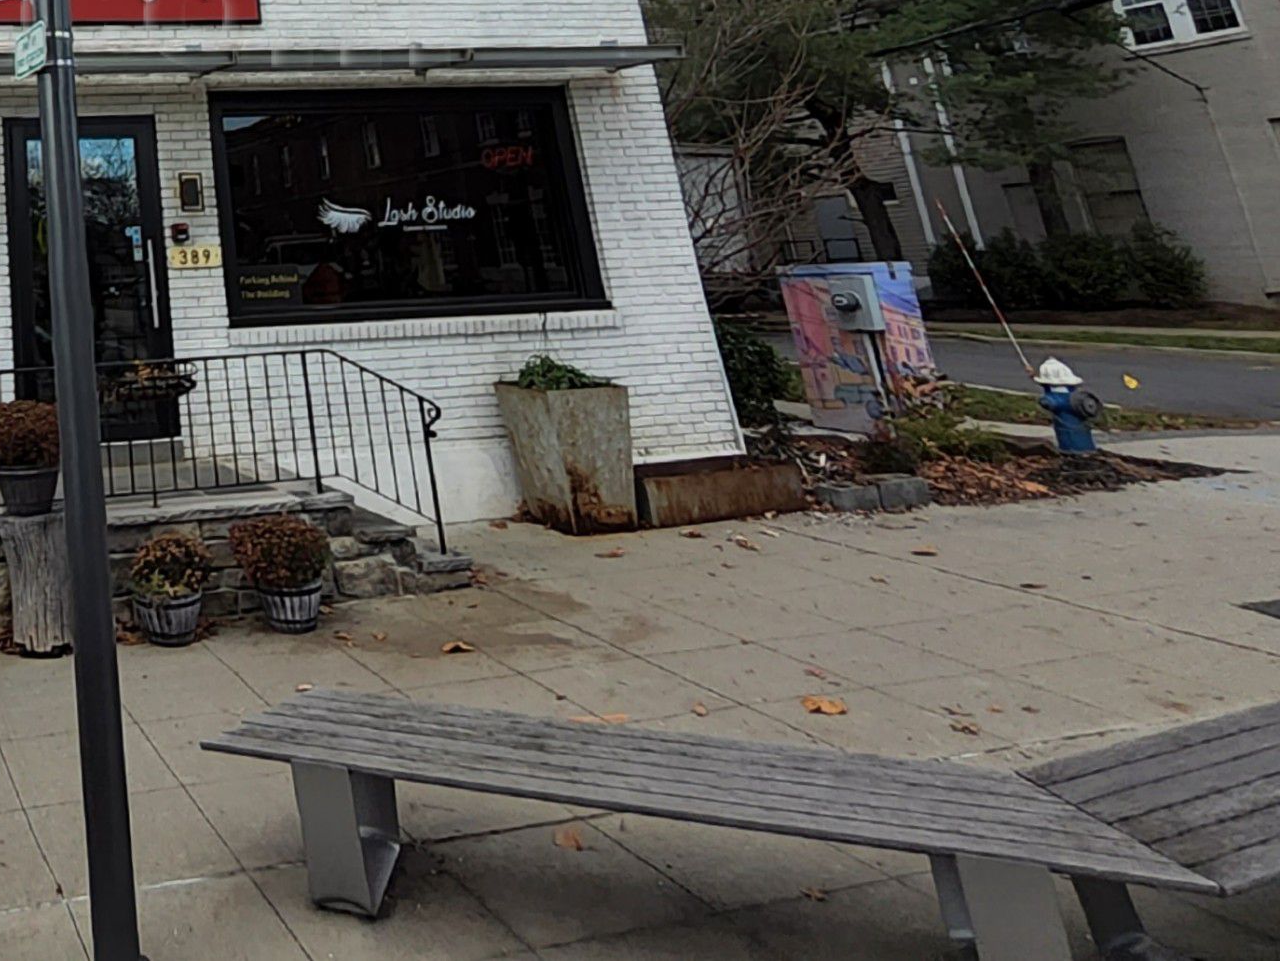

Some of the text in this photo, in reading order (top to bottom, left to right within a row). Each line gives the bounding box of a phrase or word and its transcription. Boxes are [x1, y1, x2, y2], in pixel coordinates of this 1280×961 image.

[481, 145, 534, 168] OPEN
[378, 195, 477, 227] Lash Studio
[178, 248, 211, 266] 389
